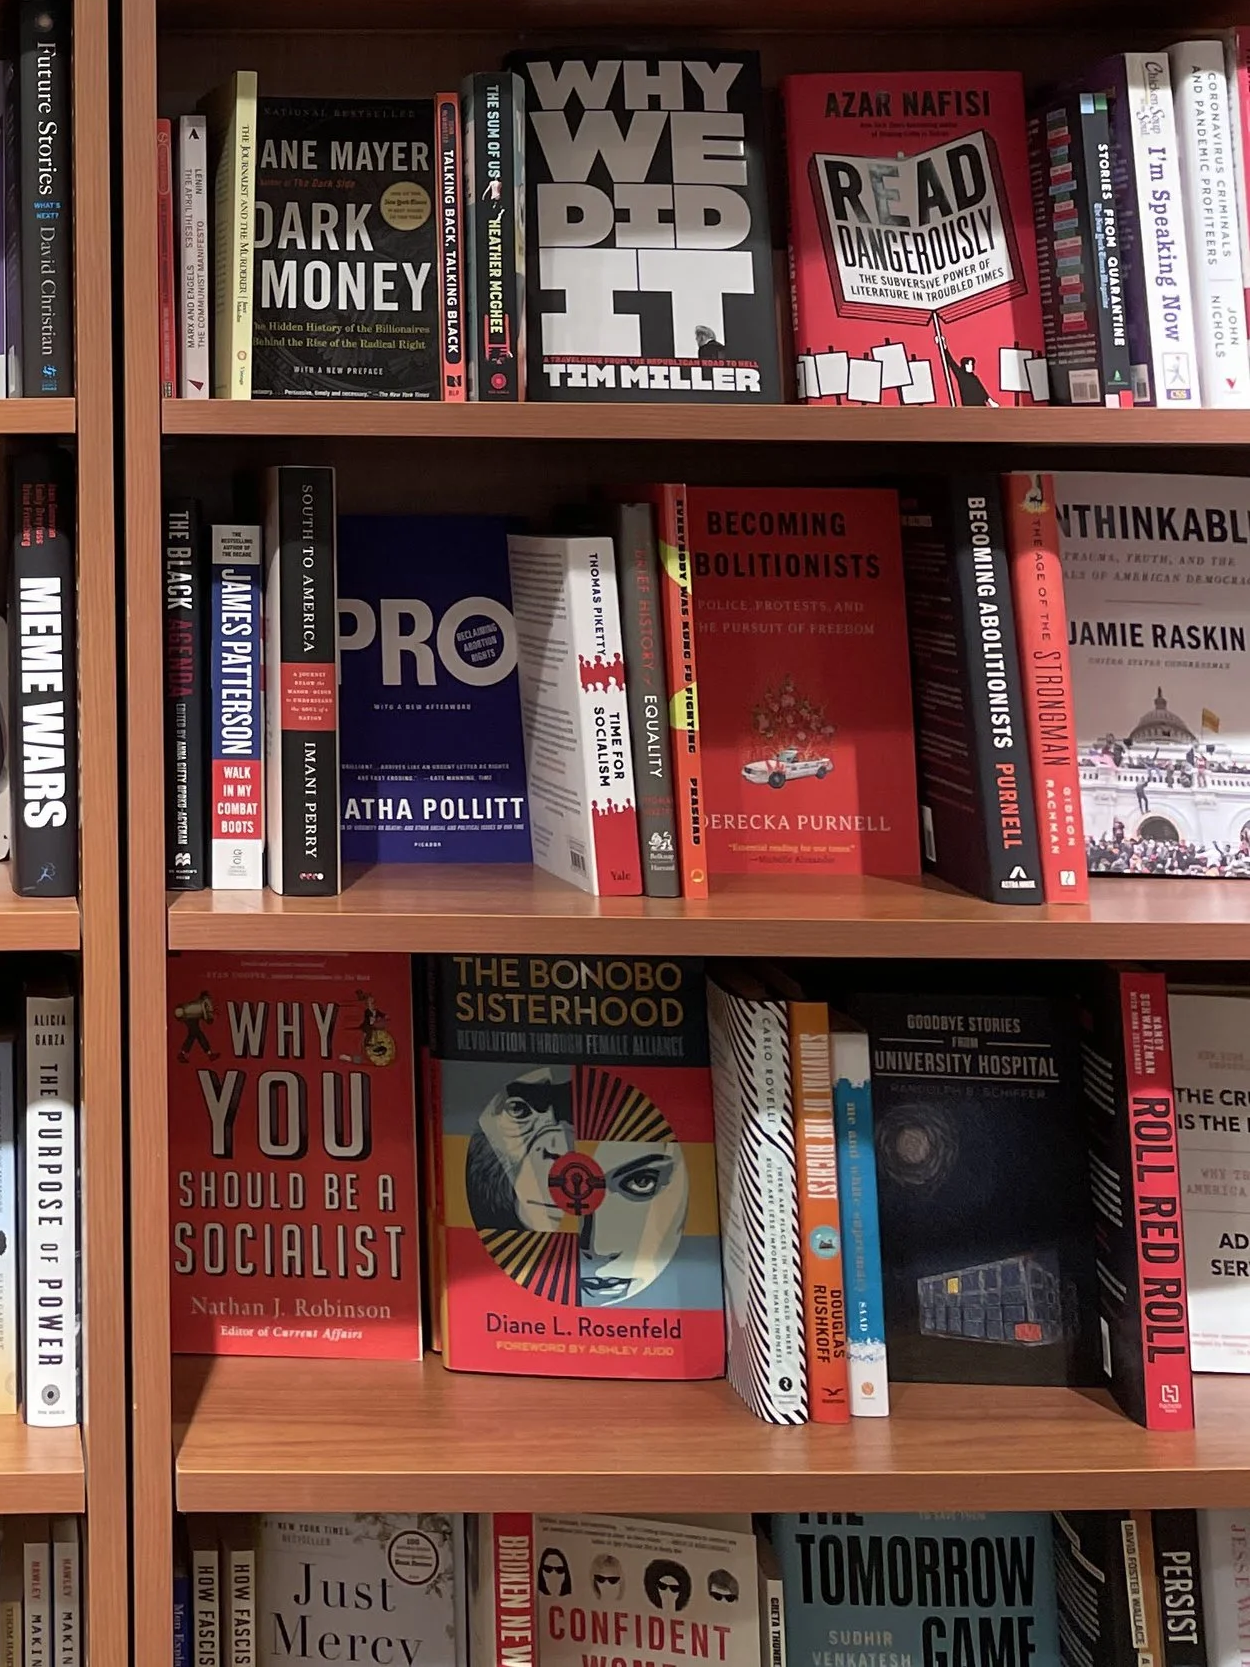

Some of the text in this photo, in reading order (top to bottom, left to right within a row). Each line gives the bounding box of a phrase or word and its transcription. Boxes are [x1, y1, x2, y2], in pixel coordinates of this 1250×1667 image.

[37, 41, 59, 195] Future Stories
[526, 60, 744, 110] WHY
[824, 90, 991, 118] AZAR NAFISI
[529, 111, 748, 185] WE
[537, 183, 752, 249] DID
[824, 142, 988, 229] READ
[444, 149, 459, 354] TALKING BACK, TALKING BLACK
[837, 206, 997, 276] DANGEROUSLY
[1148, 190, 1177, 287] Speaking
[39, 226, 56, 355] David Christian
[539, 249, 755, 359] IT
[1162, 295, 1180, 342] Now
[543, 364, 761, 392] TIM MILLER
[221, 569, 254, 755] JAMES PATTERSON
[966, 495, 1022, 849] BECOMING ABOLITIONISTS PURNELL
[19, 576, 67, 829] MEME WARS
[223, 785, 252, 797] IN MY
[224, 766, 251, 779] WALK
[217, 802, 258, 815] COMBAT
[221, 820, 254, 834] BOOTS
[452, 957, 683, 992] THE BONOBO
[227, 1000, 339, 1060] WHY
[455, 992, 684, 1028] SISTERHOOD
[199, 1069, 372, 1161] YOU
[178, 1170, 396, 1212] SHOULD BE A
[173, 1222, 406, 1280] SOCIALIST
[1132, 1097, 1184, 1365] ROLL RED ROLL
[487, 1313, 682, 1339] Diane L. Rosenfeld
[795, 1534, 1035, 1609] TOMORROW
